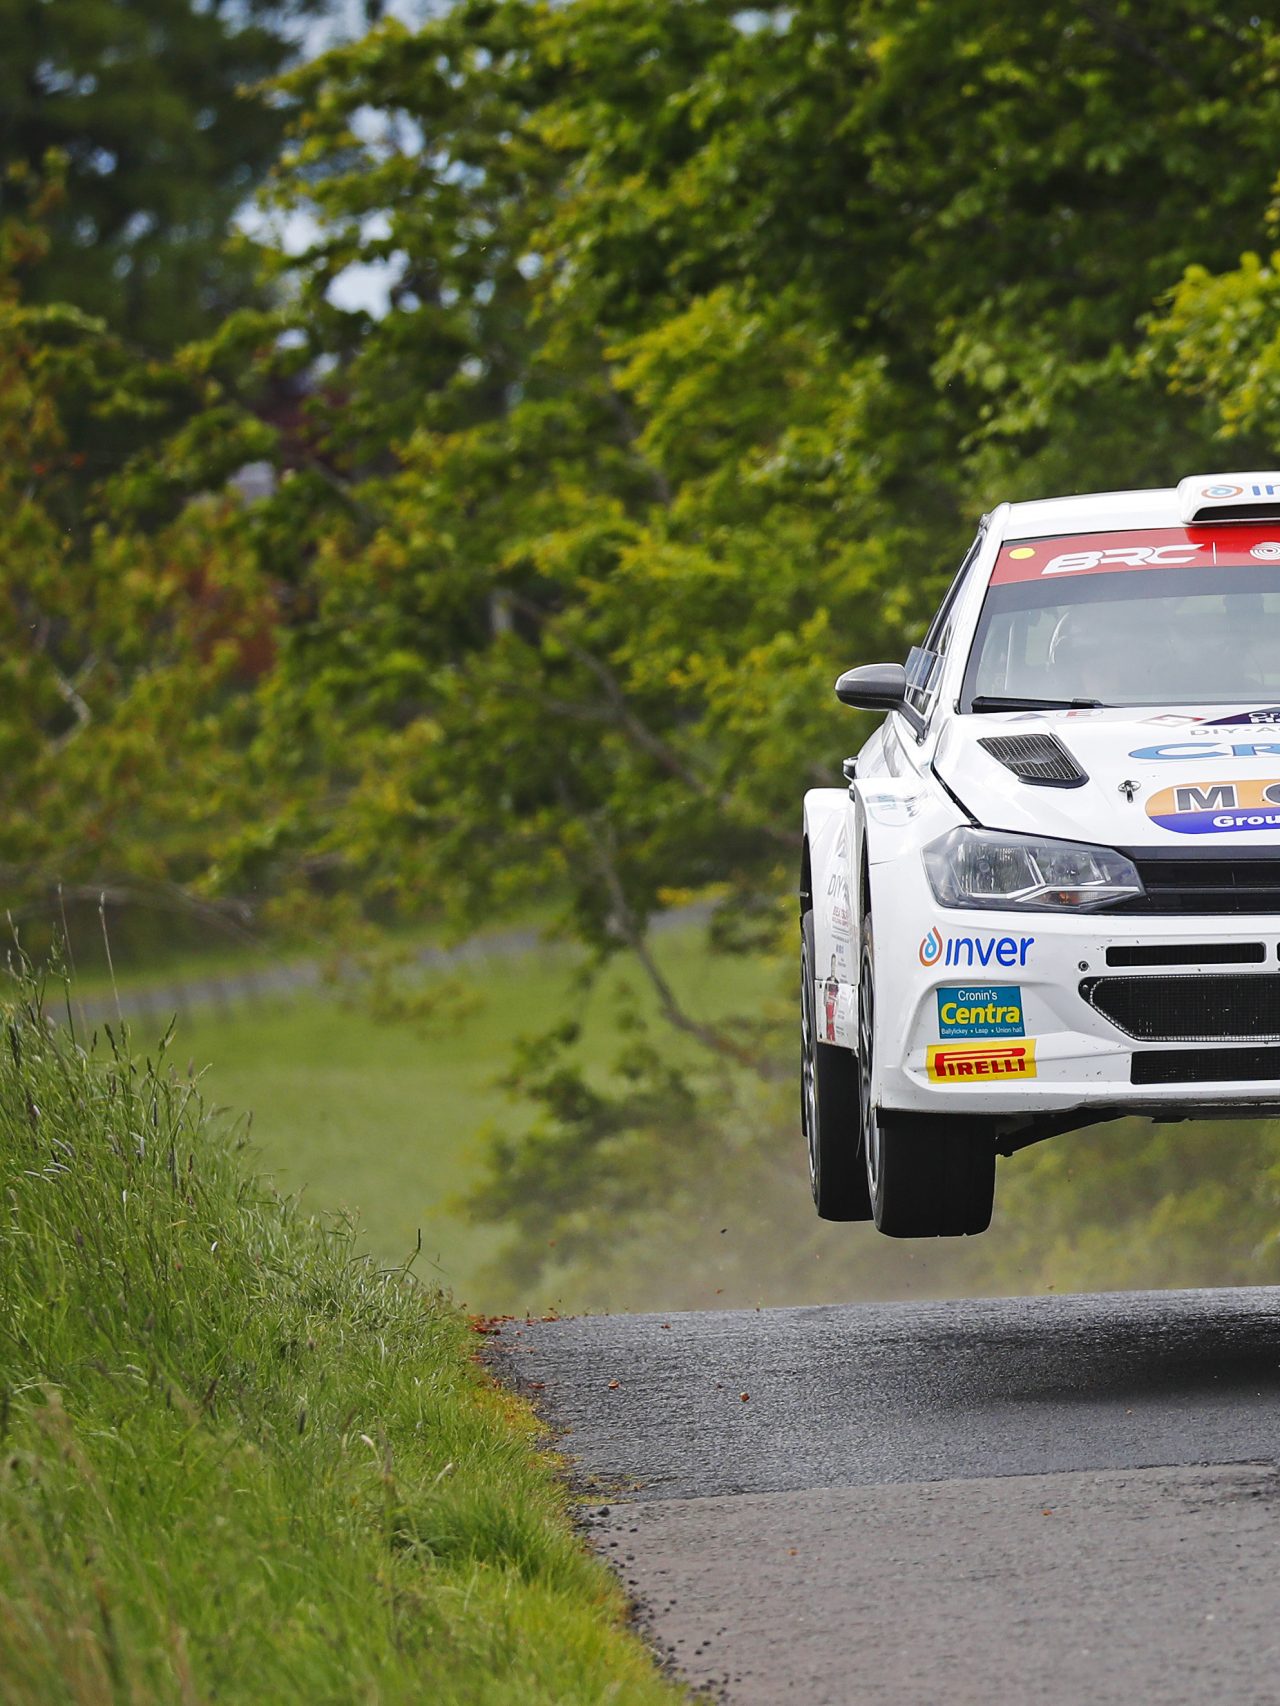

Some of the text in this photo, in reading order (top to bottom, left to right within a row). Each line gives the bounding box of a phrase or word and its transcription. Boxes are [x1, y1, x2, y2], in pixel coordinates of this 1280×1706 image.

[1041, 544, 1205, 575] BRC
[1174, 785, 1238, 812] M
[945, 937, 1035, 966] inver
[958, 990, 998, 1001] Cronin's
[941, 1002, 1020, 1025] Centra
[974, 1027, 989, 1035] Leap
[935, 1047, 1026, 1077] PIRELLI
